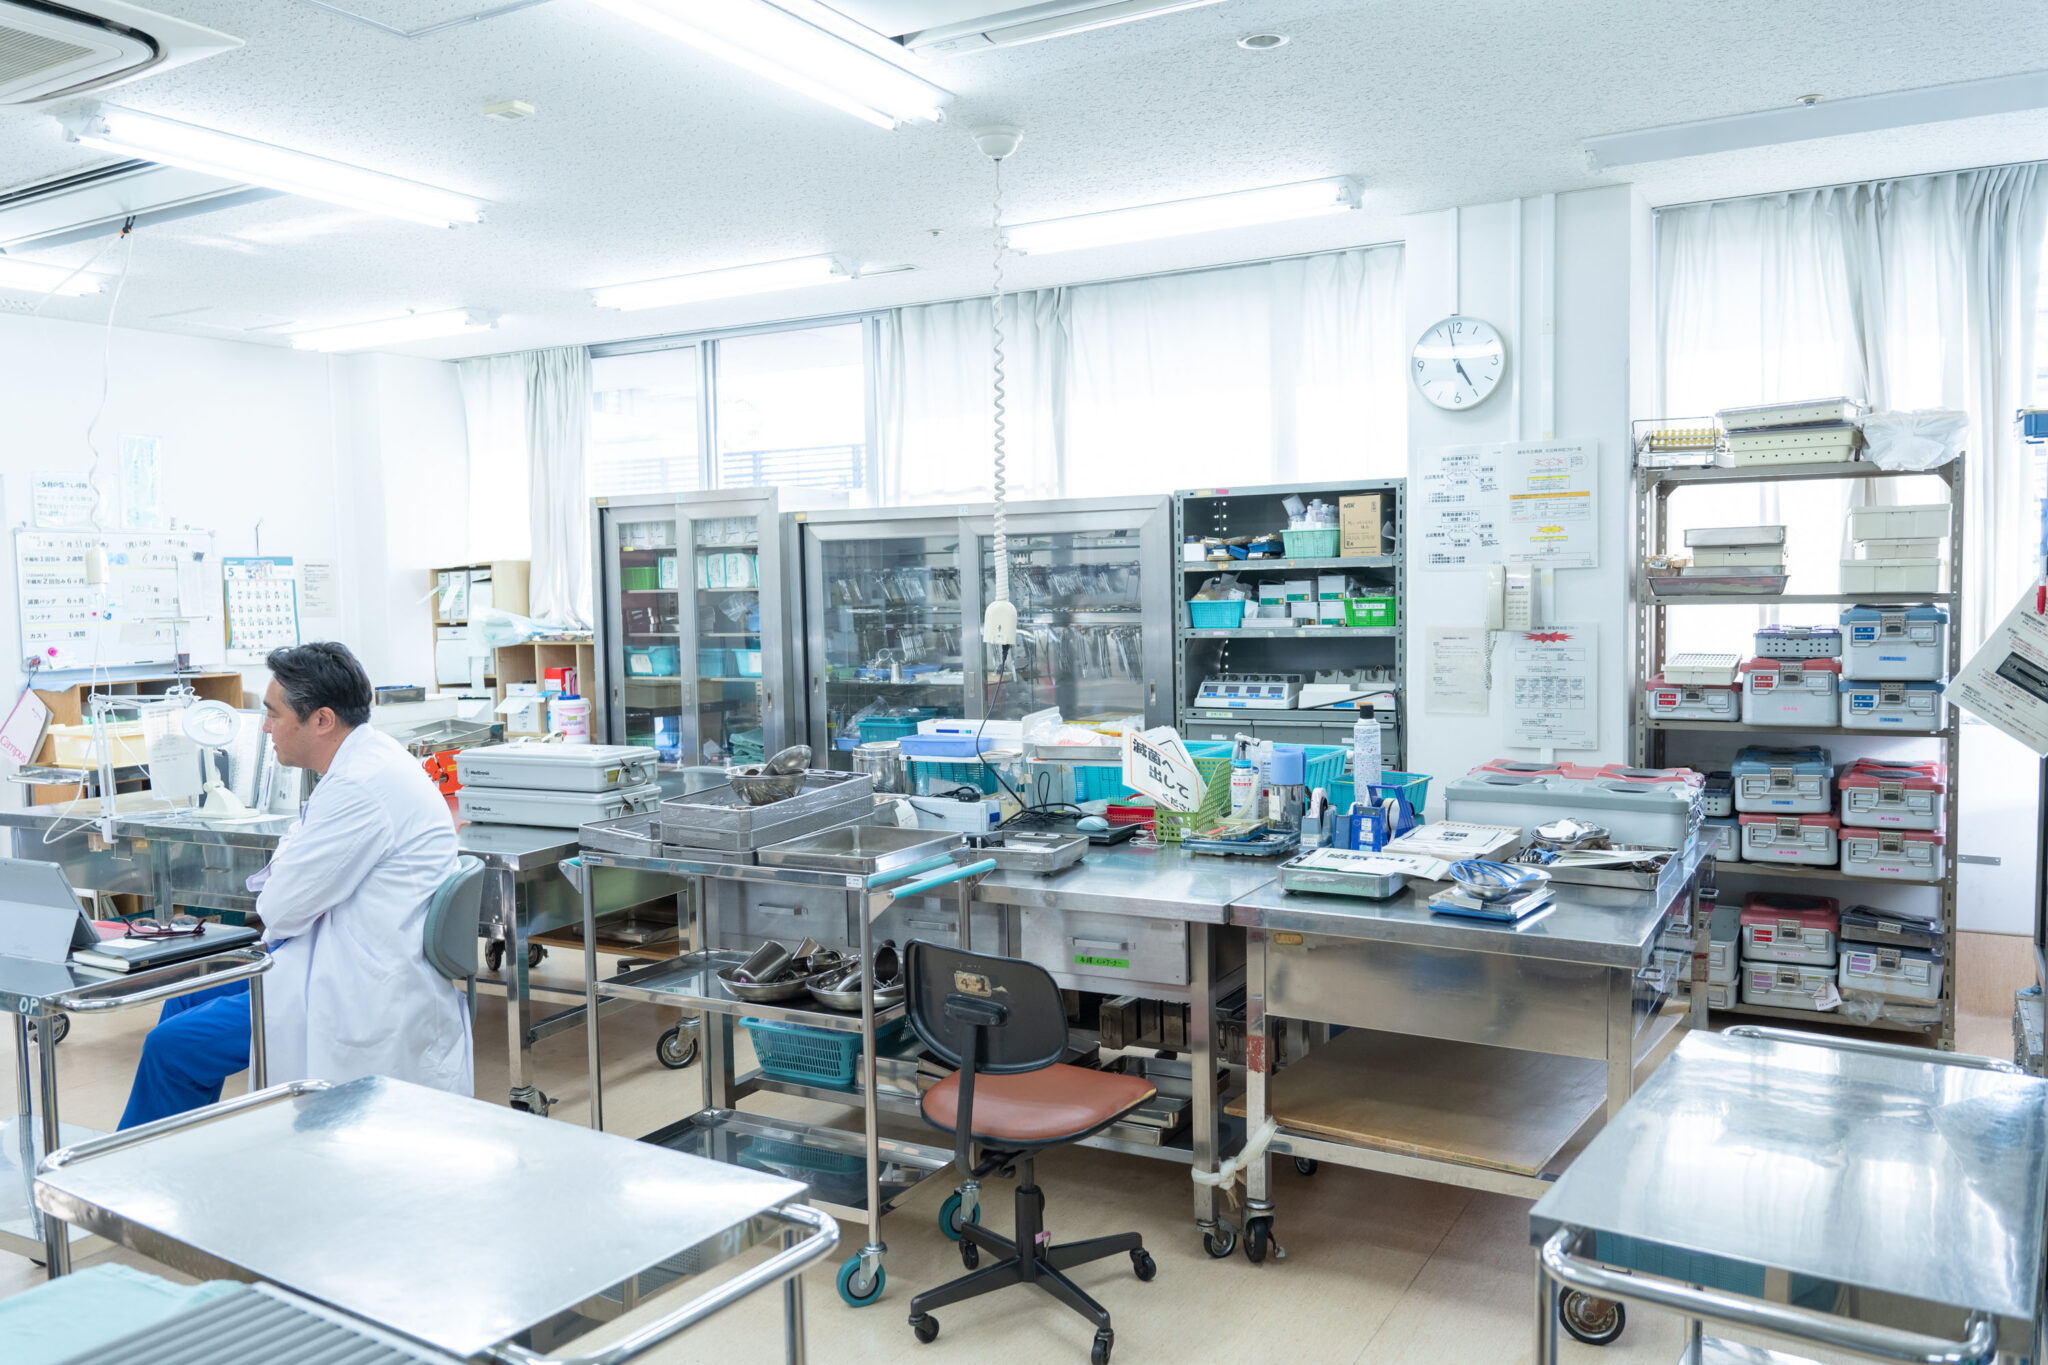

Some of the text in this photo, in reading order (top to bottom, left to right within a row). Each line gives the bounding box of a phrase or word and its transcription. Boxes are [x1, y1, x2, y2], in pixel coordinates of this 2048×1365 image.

[1452, 322, 1463, 334] 12
[1417, 354, 1499, 373] 9 3
[1454, 392, 1462, 404] 6
[0, 734, 27, 763] Campus
[1132, 737, 1174, 774] 滅菌へ
[1148, 764, 1189, 799] 出して
[18, 996, 39, 1015] OP
